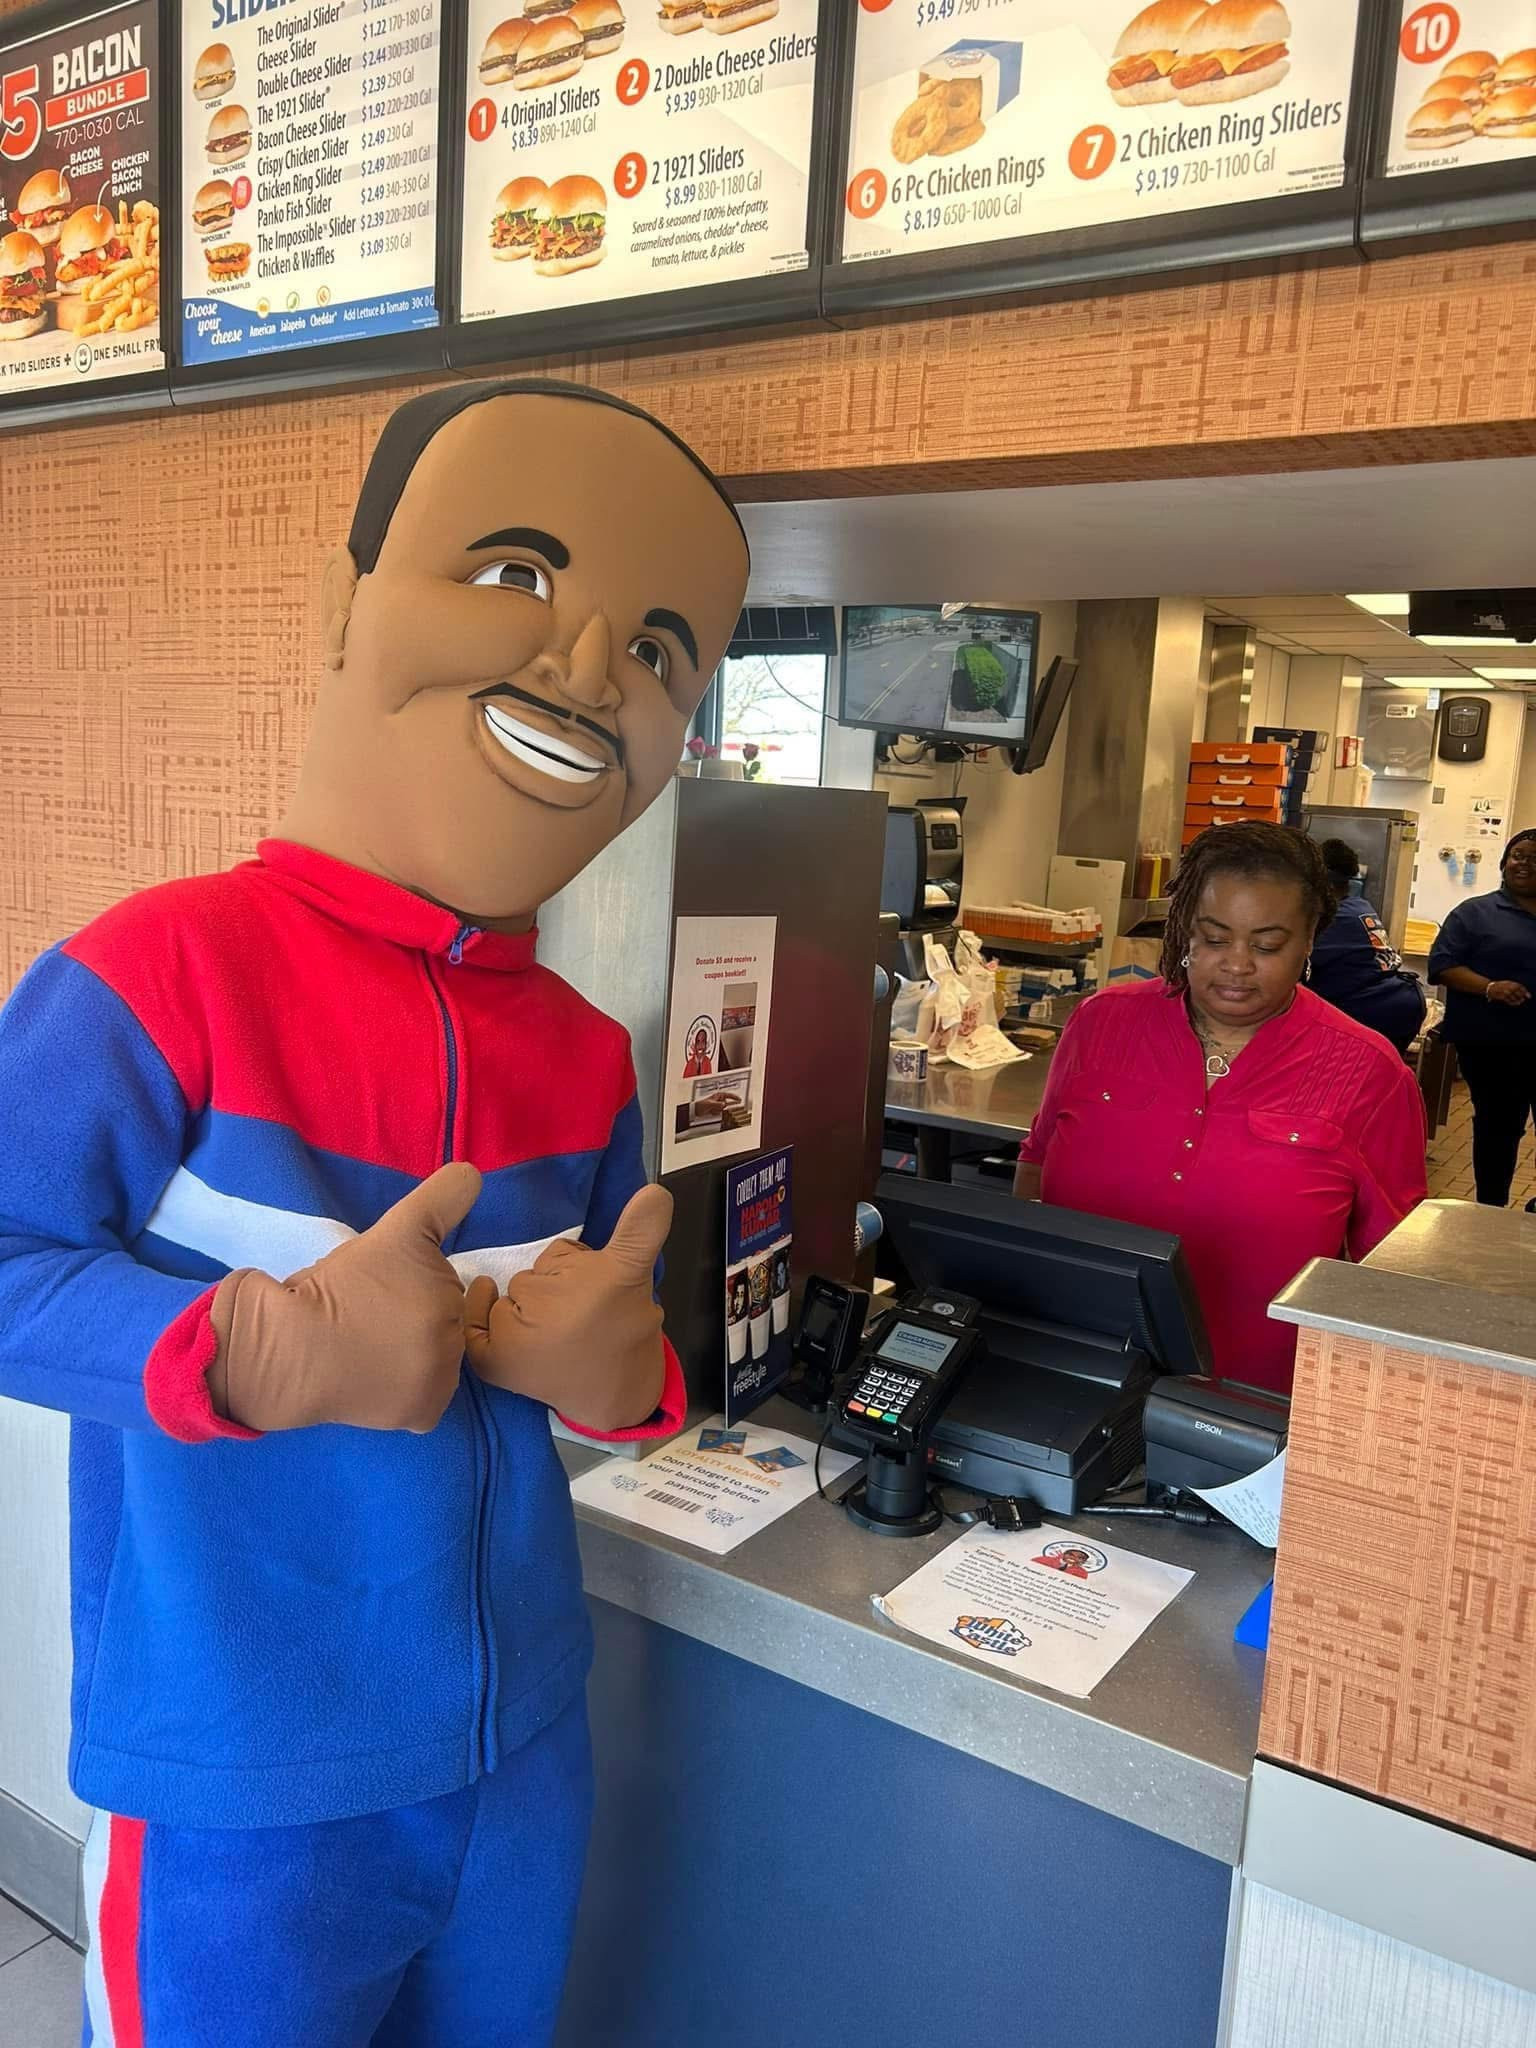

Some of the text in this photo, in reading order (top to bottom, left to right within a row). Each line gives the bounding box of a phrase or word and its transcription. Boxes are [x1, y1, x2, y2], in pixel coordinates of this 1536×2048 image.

[258, 27, 273, 46] The
[275, 15, 311, 42] Original
[258, 3, 433, 73] Cheese Slider 170-180 Cal
[1410, 13, 1450, 55] 10
[52, 24, 142, 96] BACON
[258, 32, 433, 98] Double Cheese Slider 300-330 Cal
[654, 33, 818, 92] 2 Double Cheese Sliders
[66, 81, 126, 117] BUNDLE
[258, 106, 273, 125] The
[276, 99, 297, 120] 1921
[387, 72, 401, 89] 250
[402, 66, 415, 83] Cal
[626, 67, 640, 97] 2
[698, 72, 763, 108] 930-1320 Cal
[258, 88, 432, 151] Bacon Cheese Slider 220-230 Cal
[477, 105, 488, 134] 1
[501, 86, 601, 129] 4 Original Sliders
[55, 108, 144, 149] 770-1030 CAL
[540, 112, 597, 144] 890-1240 Cal
[1120, 97, 1343, 162] 2 Chicken Ring Sliders
[70, 146, 100, 162] BACON
[111, 150, 150, 171] CHICKEN
[258, 120, 413, 179] Crispy Chicken Slider 230 Cal
[652, 146, 745, 185] 2 1921 Sliders
[1084, 134, 1105, 170] 7
[1182, 153, 1250, 186] 730-1100
[1253, 147, 1276, 174] Cal
[70, 158, 104, 178] CHEESE
[111, 166, 142, 184] BACON
[258, 179, 292, 203] Chicken
[293, 172, 313, 194] Ring
[315, 166, 342, 189] Slider
[386, 148, 417, 170] 200-210
[419, 144, 431, 162] Cal
[624, 159, 638, 190] 3
[697, 170, 763, 202] 830-1180 Cal
[891, 155, 1045, 204] 6 Pc Chicken Rings
[111, 179, 142, 198] RANCH
[258, 172, 430, 228] Panko Fish Slider 340-350 Cal
[861, 176, 877, 209] 6
[632, 199, 769, 235] Seared & seasoned 100% beef patty,
[943, 191, 1022, 225] 650-1000 Cal
[258, 234, 273, 254] The
[329, 216, 356, 239] Slider
[385, 203, 417, 225] 220-230
[418, 200, 430, 218] Cal
[630, 233, 675, 253] caramelized
[675, 230, 702, 247] onions,
[740, 217, 769, 234] cheese,
[258, 231, 412, 279] Chicken & Waffles 350 Cal
[651, 240, 745, 268] tomato, lettuce, & pickles
[185, 303, 218, 320] Choose
[198, 317, 222, 337] your
[249, 323, 277, 337] American
[343, 310, 356, 322] Add
[357, 304, 380, 319] Lettuce
[379, 304, 386, 317] &
[386, 300, 410, 314] Tomato
[211, 327, 243, 346] cheese
[9, 362, 26, 375] TWO
[28, 355, 61, 372] SLIDERS
[94, 347, 110, 361] ONE
[112, 342, 141, 358] SMALL
[696, 957, 715, 966] Donate
[733, 1363, 768, 1398] freestyle
[1194, 1421, 1223, 1436] EPSON
[647, 1463, 761, 1504] your barcode before
[662, 1455, 771, 1496] Don't forget to scan
[675, 1447, 783, 1488] LOYALTY MEMBERS
[664, 1480, 718, 1502] payment
[1022, 1565, 1047, 1578] Power
[1060, 1579, 1107, 1598] Fatherhood
[969, 1619, 1023, 1646] White
